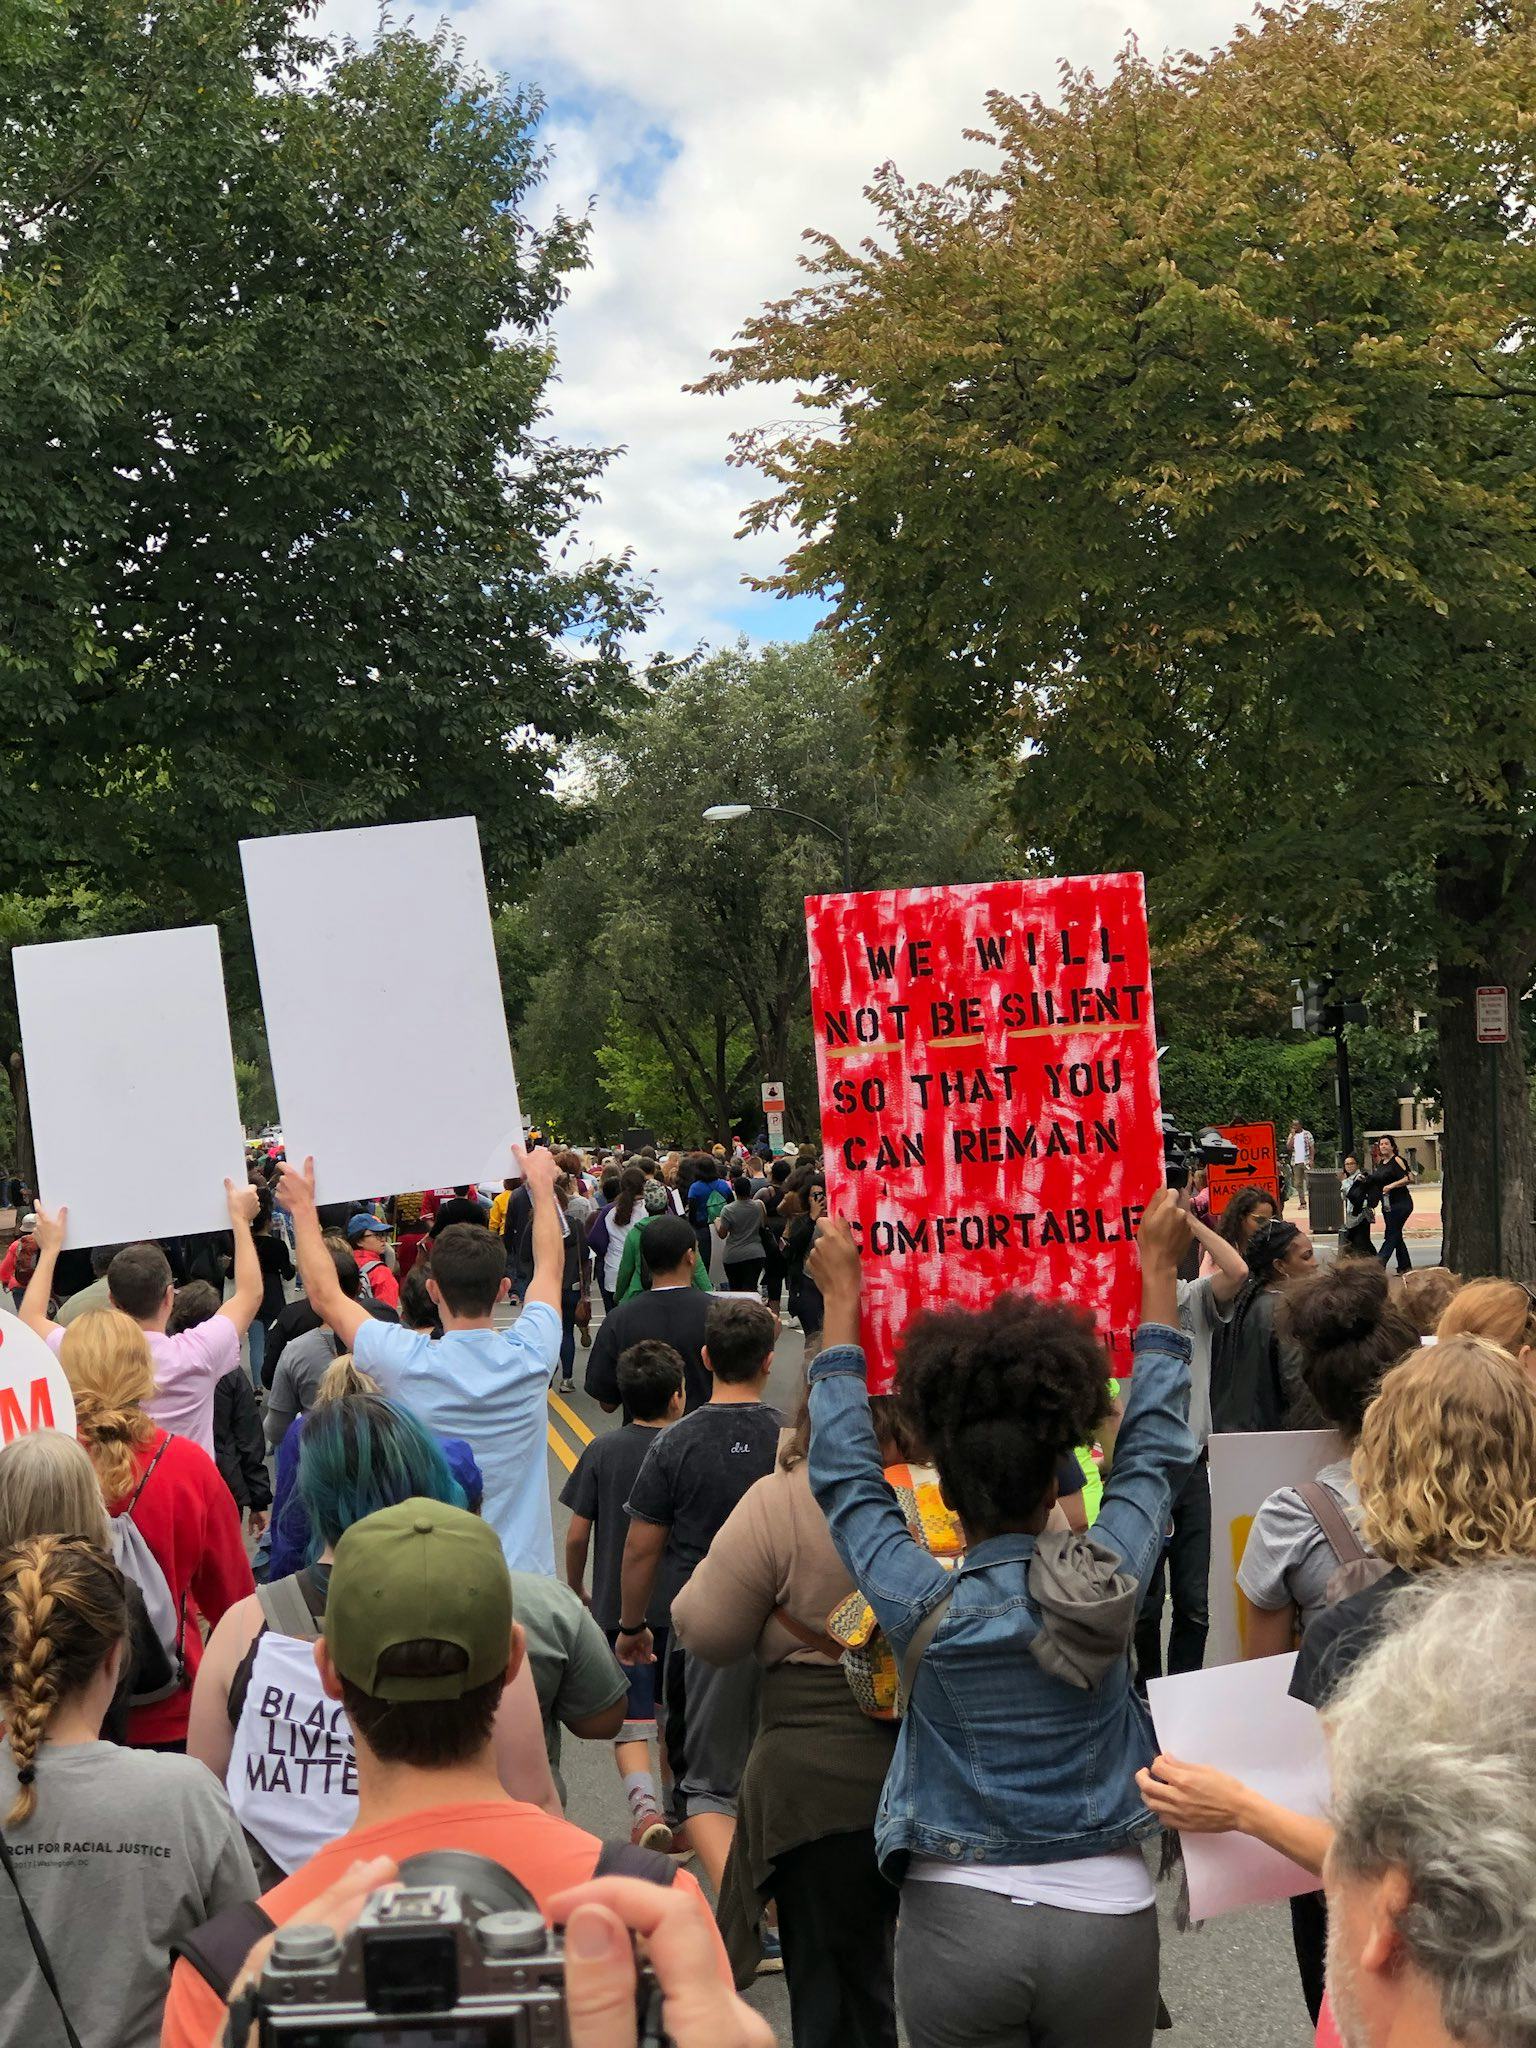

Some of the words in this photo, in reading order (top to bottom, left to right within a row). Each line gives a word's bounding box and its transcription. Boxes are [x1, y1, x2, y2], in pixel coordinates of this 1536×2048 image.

[867, 940, 933, 980] WE
[976, 927, 1125, 971] WILL
[825, 1004, 909, 1045] NOT
[931, 997, 984, 1037] BE
[1002, 985, 1145, 1027] SILENT
[833, 1077, 885, 1114] SO
[911, 1065, 1018, 1110] THAT
[1044, 1059, 1122, 1098] YOU
[843, 1133, 926, 1171] CAN
[953, 1118, 1119, 1164] REMAIN
[1240, 1146, 1271, 1161] OUR
[260, 1685, 345, 1733] BLAC
[246, 1753, 359, 1796] MATTE
[6, 1844, 34, 1856] RCH
[37, 1842, 60, 1854] FOR
[63, 1842, 112, 1853] RACIAL
[116, 1842, 171, 1858] JUSTICE
